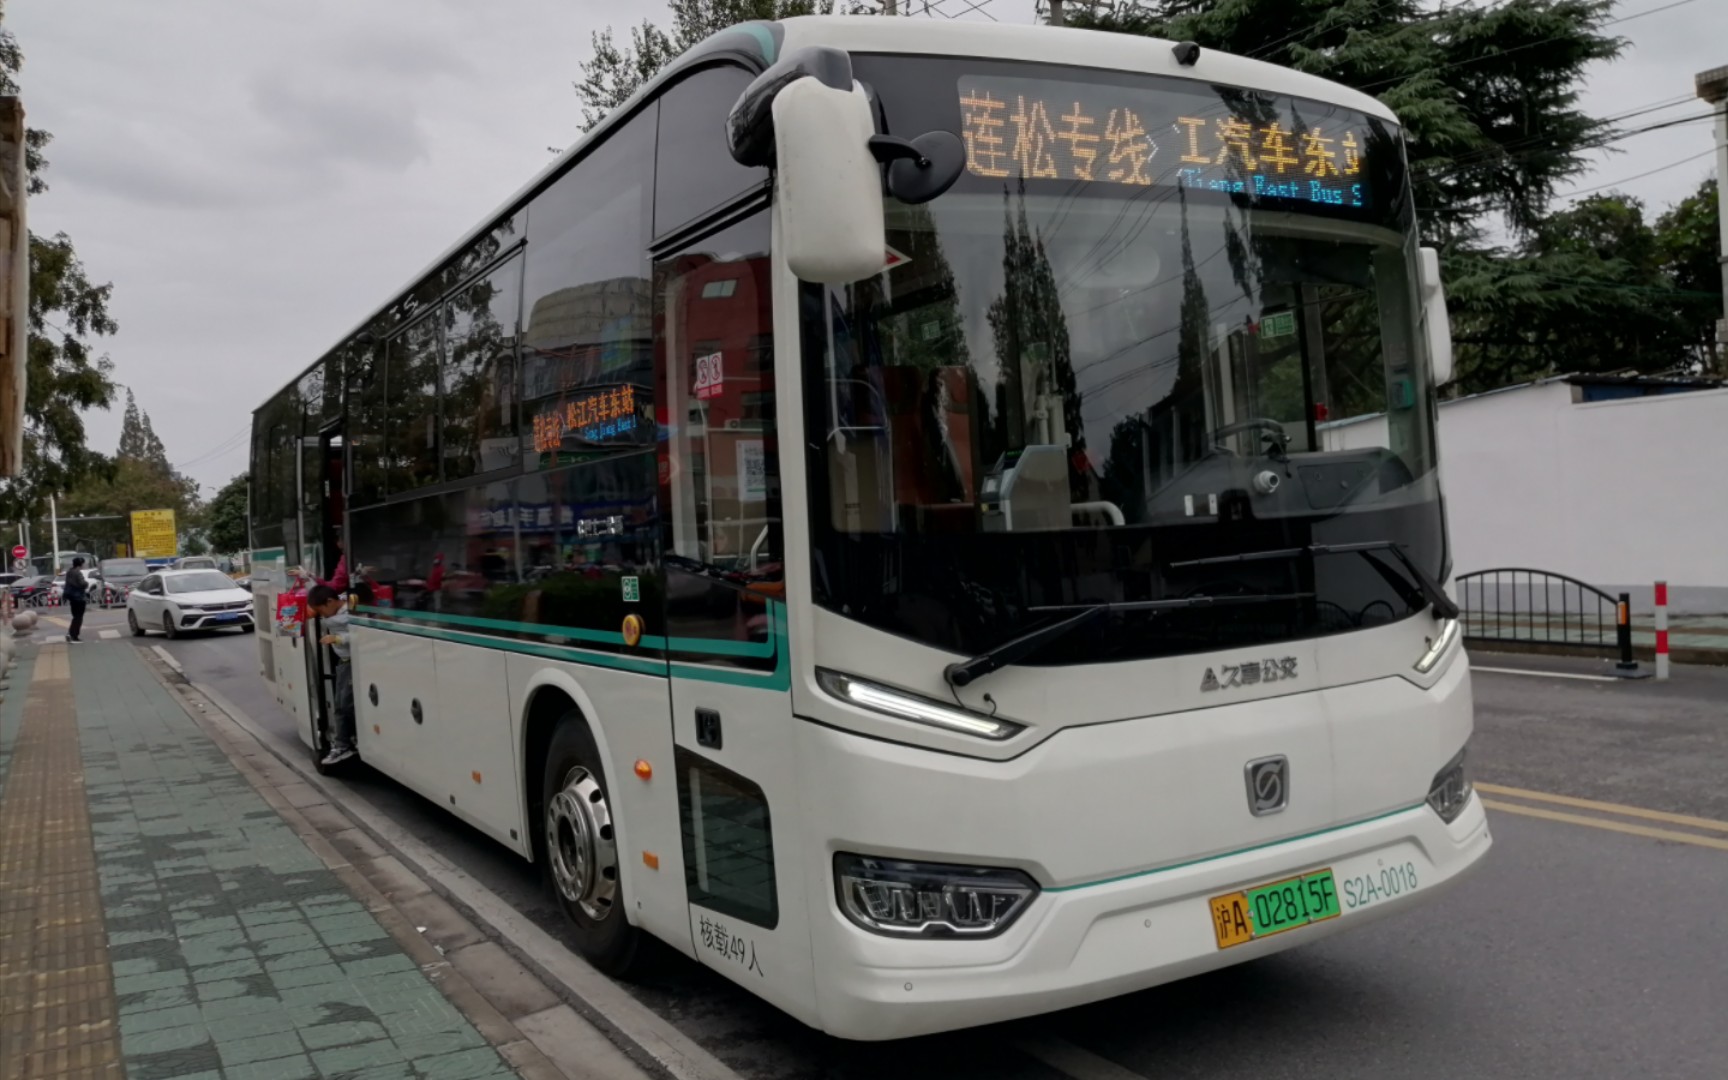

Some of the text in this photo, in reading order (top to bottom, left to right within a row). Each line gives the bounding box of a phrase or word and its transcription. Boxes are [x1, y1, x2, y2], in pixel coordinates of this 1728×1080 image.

[1309, 180, 1342, 204] Bus
[1343, 861, 1418, 908] S2A-0018
[700, 914, 764, 978] 核载49人
